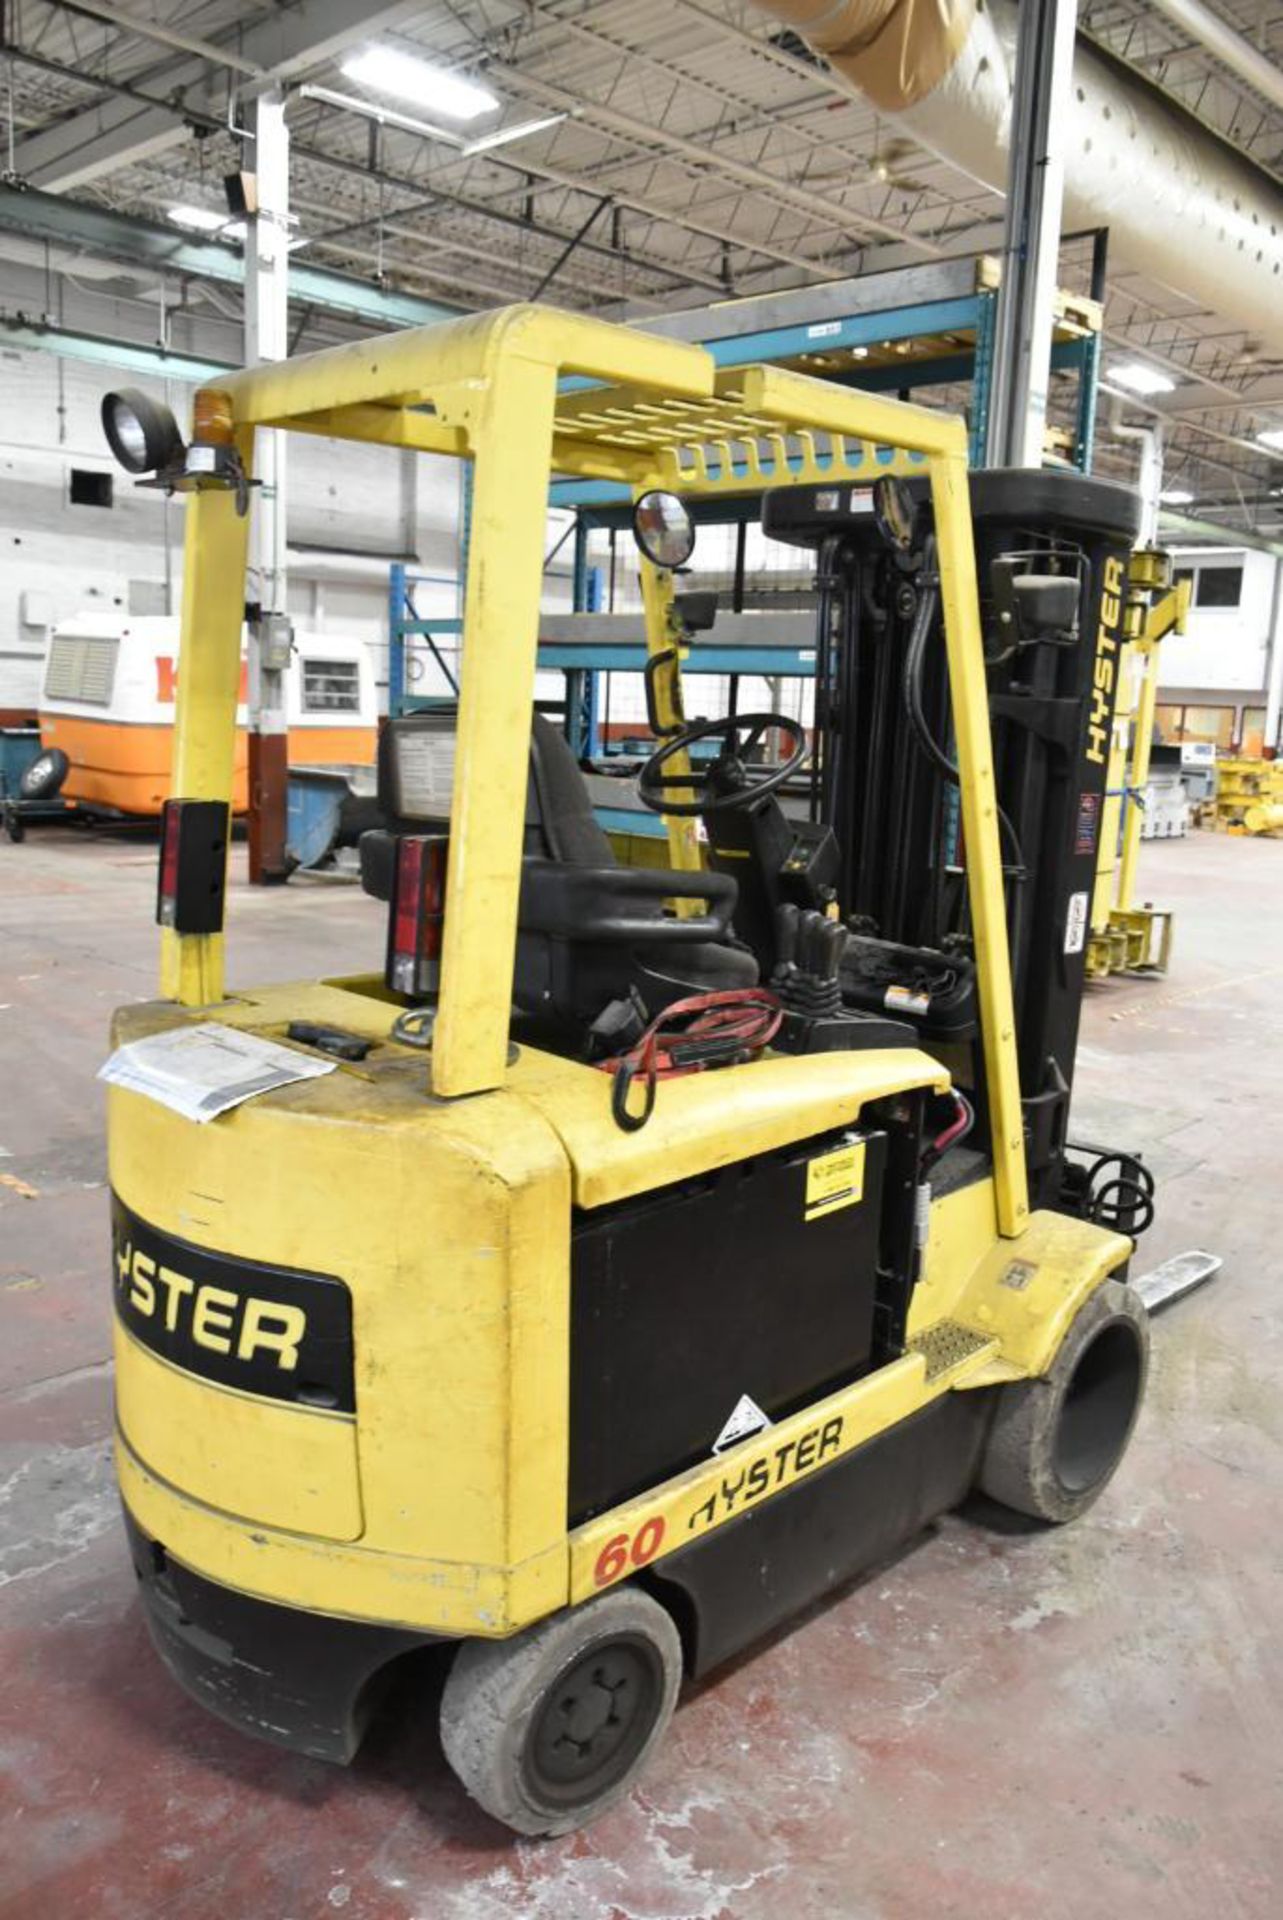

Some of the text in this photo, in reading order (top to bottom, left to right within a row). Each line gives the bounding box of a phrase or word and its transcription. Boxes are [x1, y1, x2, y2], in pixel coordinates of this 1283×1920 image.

[1086, 556, 1124, 764] HYSTER
[116, 1241, 307, 1371] YSTER
[594, 1515, 665, 1588] 60
